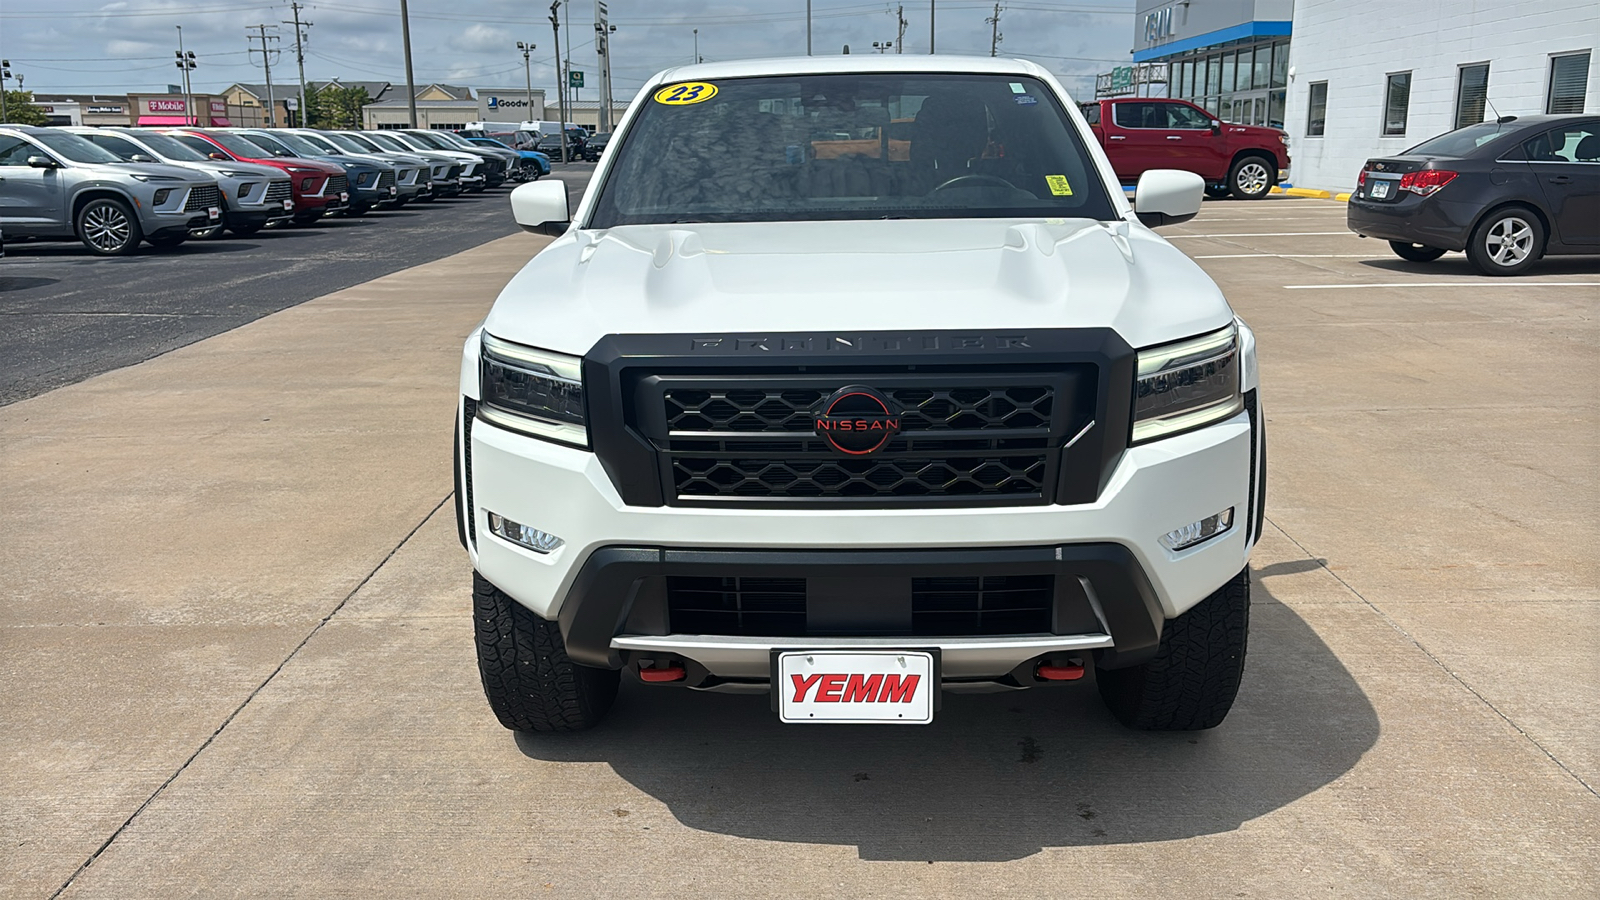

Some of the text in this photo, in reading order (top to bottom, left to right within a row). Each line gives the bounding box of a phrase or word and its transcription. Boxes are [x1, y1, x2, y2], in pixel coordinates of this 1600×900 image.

[665, 84, 705, 102] 23
[158, 101, 184, 111] Mobile
[691, 335, 1032, 352] FRONTIER
[817, 418, 899, 431] NISSAN
[790, 674, 922, 704] YEMM
